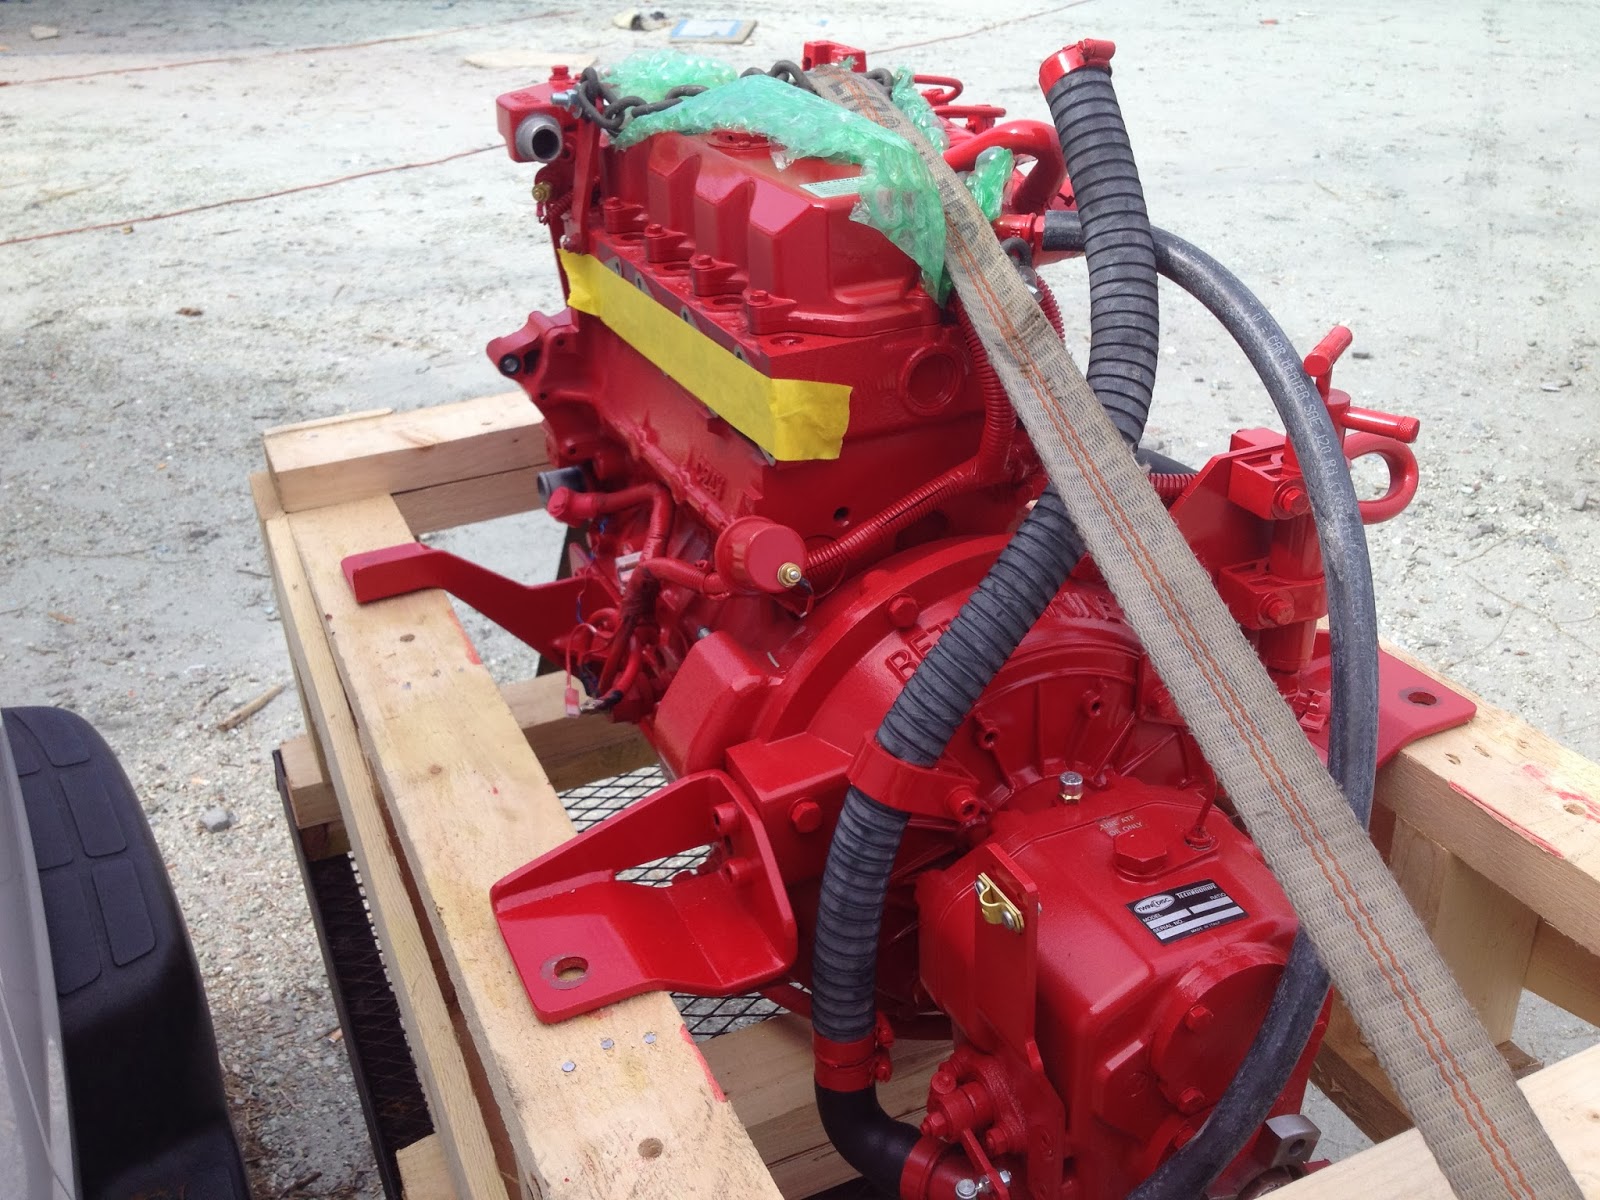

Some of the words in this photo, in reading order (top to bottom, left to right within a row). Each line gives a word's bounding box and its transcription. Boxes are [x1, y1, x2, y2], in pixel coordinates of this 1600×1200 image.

[1267, 335, 1287, 358] CAR
[1281, 357, 1310, 401] HEATER
[1304, 404, 1324, 427] SAE
[885, 619, 951, 685] BET
[1101, 819, 1119, 830] USE
[1121, 814, 1135, 824] ATF
[1122, 821, 1143, 832] ONLY
[1210, 892, 1227, 900] RATIO
[1137, 902, 1154, 912] TWIN
[1155, 897, 1171, 908] DISC
[1142, 912, 1163, 923] MODEL
[1153, 923, 1173, 933] SERIAL
